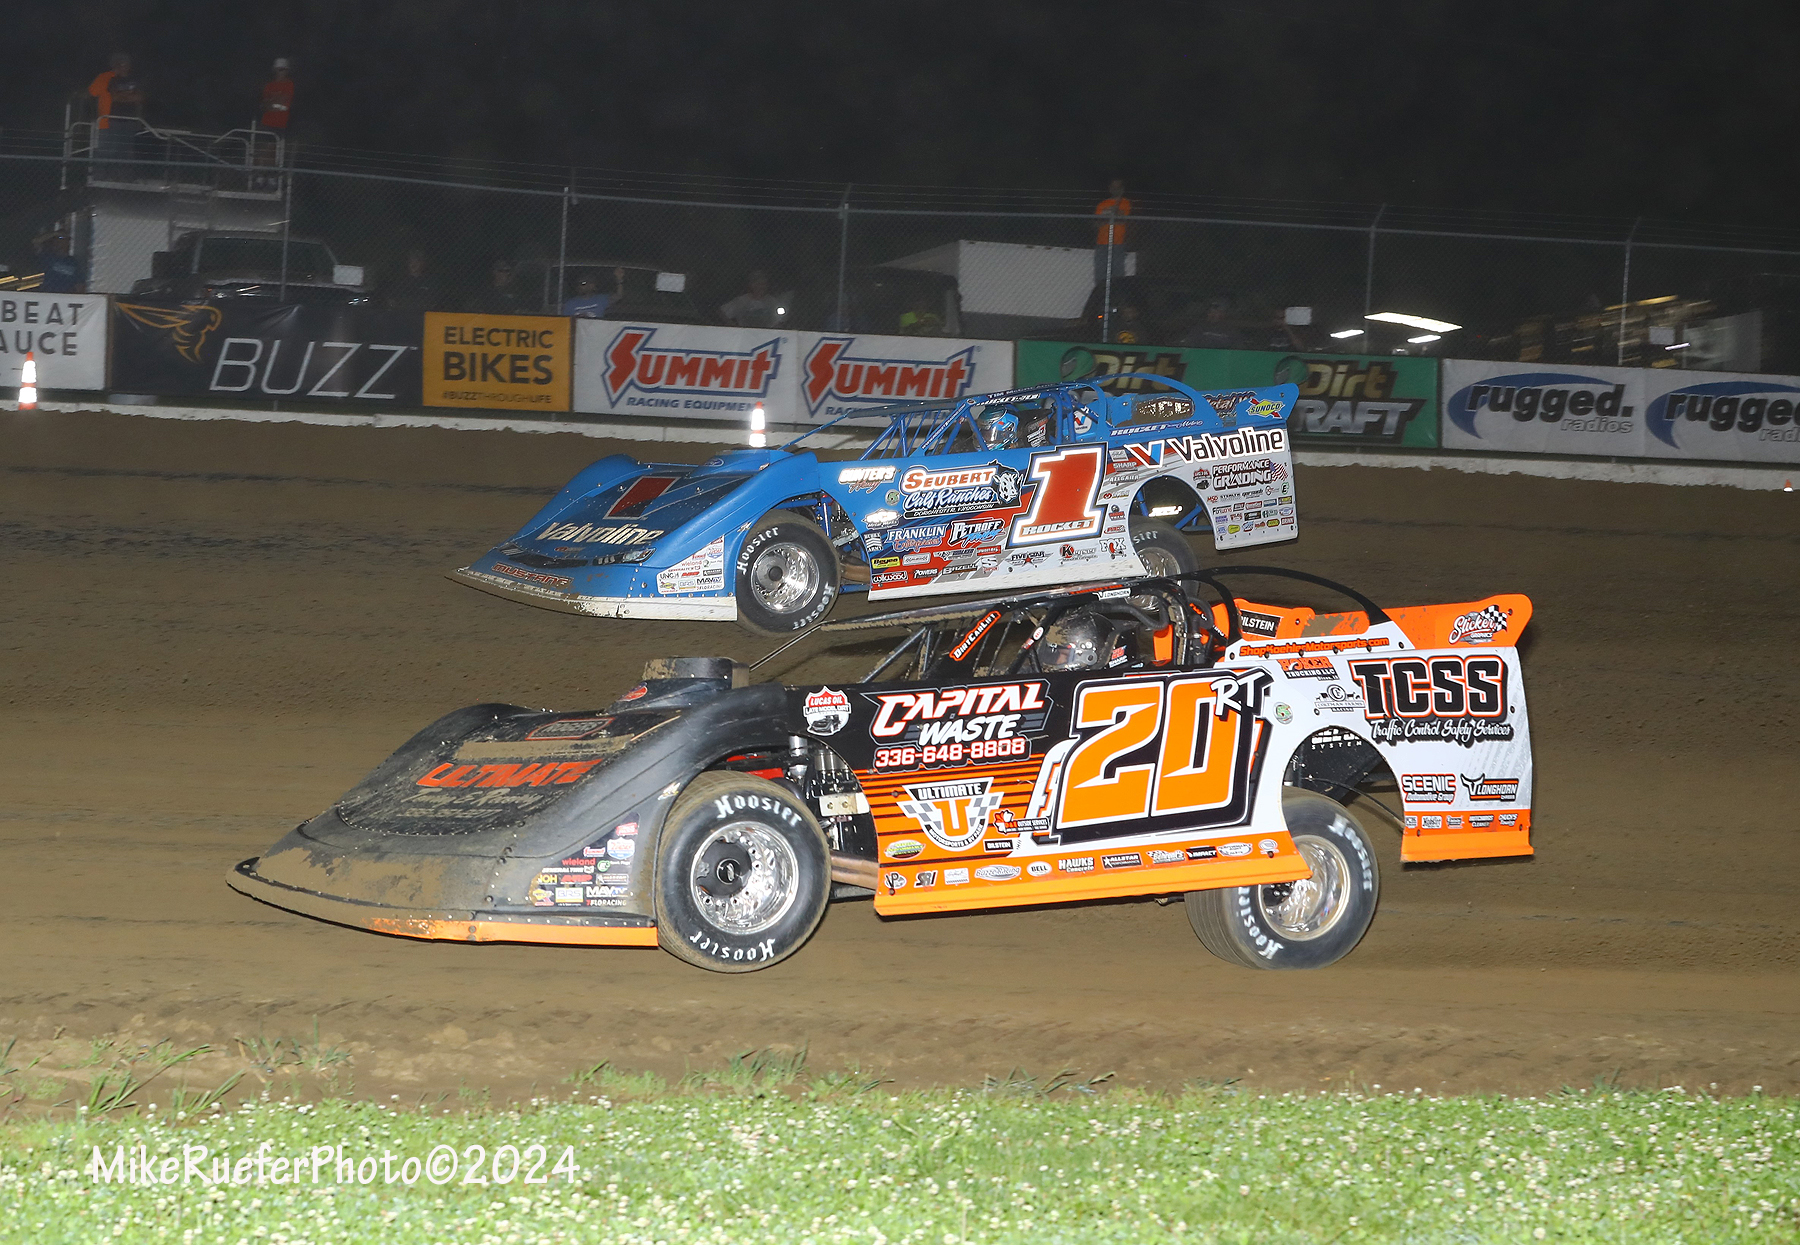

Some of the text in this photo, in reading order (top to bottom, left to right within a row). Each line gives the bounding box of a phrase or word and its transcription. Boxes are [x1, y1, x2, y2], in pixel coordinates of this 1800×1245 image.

[2, 300, 84, 325] BEAT
[444, 326, 554, 349] ELECTRIC
[209, 337, 408, 399] BUZZ
[444, 351, 553, 385] BIKES
[1302, 360, 1393, 398] Dirt
[626, 397, 680, 408] RACING
[1250, 403, 1281, 413] SUNOCO
[1465, 384, 1634, 422] rugged.
[1664, 392, 1800, 433] rugge
[1560, 416, 1633, 433] radios
[1167, 427, 1285, 463] Valvoline
[1212, 459, 1270, 475] PERFORMANCE
[904, 470, 994, 490] SEUBERT
[1212, 469, 1272, 489] GRADING
[905, 490, 938, 510] Calf
[934, 486, 992, 507] Ranches
[1012, 447, 1102, 543] 1
[535, 522, 665, 546] Valvoline
[888, 525, 946, 541] FRANKLIN
[1021, 518, 1095, 536] ROCKET
[736, 526, 780, 576] Hoosier
[1099, 538, 1126, 554] FOX
[1448, 614, 1495, 644] Slicker
[1239, 638, 1390, 657] ShopKoehlerMotorsports.com
[1286, 669, 1322, 678] TRUCKING
[1350, 657, 1503, 717] TCSS
[810, 695, 843, 706] LUCAS OIL
[871, 683, 1045, 737] CAPITAL
[919, 713, 1022, 746] WASTE
[1371, 720, 1402, 740] Traffic
[1404, 719, 1441, 738] Control
[1441, 718, 1473, 743] Safety
[1473, 719, 1511, 737] Services
[875, 737, 1026, 768] 336-648-8808
[1058, 671, 1267, 828] 20 RT
[1311, 740, 1362, 750] SYSTEM
[416, 758, 602, 787] ULTIMATE
[917, 783, 983, 801] ULTIMATE
[1402, 774, 1456, 793] SCENIC
[1477, 784, 1518, 795] LONGHORN
[1406, 792, 1455, 804] Automotive Group
[714, 795, 802, 828] Hoosier
[929, 829, 965, 849] MOTORSPORTS
[562, 857, 596, 866] wieland
[1058, 857, 1095, 869] HAWKS
[1110, 854, 1140, 862] ALLSTAR
[1193, 850, 1218, 858] IMPACT
[689, 931, 776, 962] Hoosier
